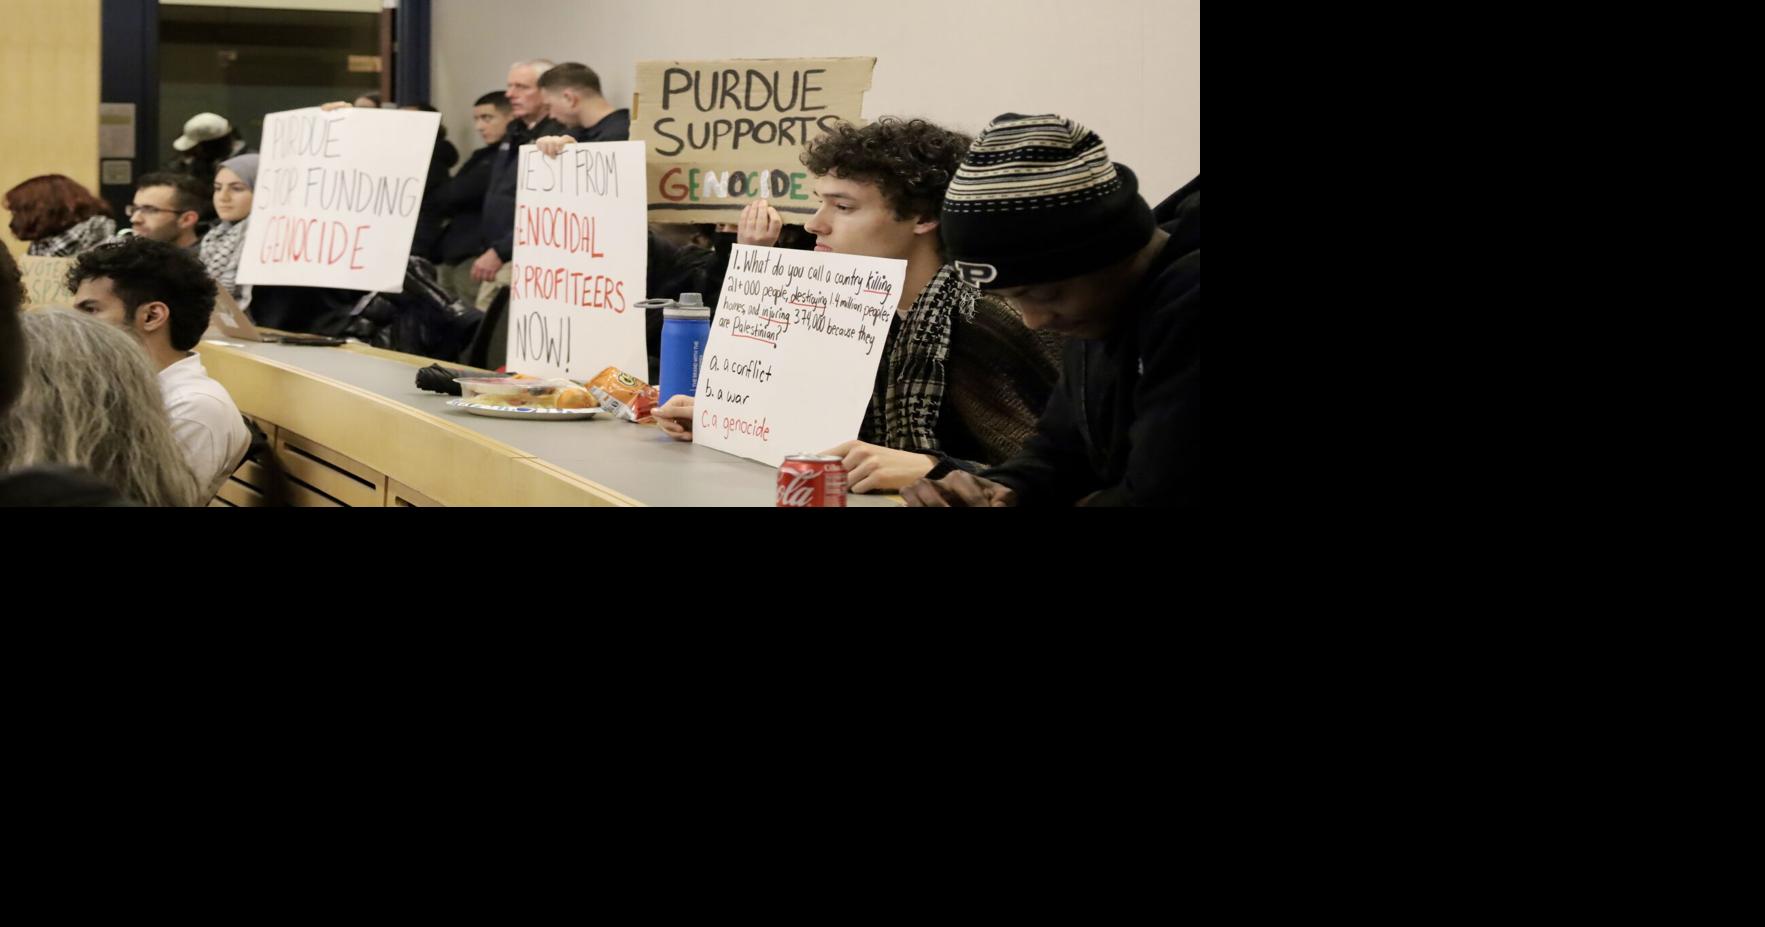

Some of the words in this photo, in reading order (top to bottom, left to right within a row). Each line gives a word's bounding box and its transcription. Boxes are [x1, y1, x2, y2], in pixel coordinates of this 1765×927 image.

[662, 67, 827, 112] PURDUE
[258, 167, 298, 210] STOP
[305, 167, 420, 218] FUNDING
[575, 150, 619, 198] FROM
[659, 167, 809, 202] GENOCIDE
[260, 216, 371, 270] GENOCIDE
[516, 205, 604, 258] ENOCIDAL
[733, 249, 741, 270] 1.
[743, 249, 771, 273] What
[772, 253, 784, 276] do
[786, 264, 804, 287] you
[807, 264, 824, 282] call
[825, 270, 831, 283] a
[954, 260, 998, 289] P
[525, 265, 626, 314] PROFITEERS
[761, 285, 789, 306] people,
[829, 292, 841, 308] 1.4
[840, 296, 862, 313] million
[516, 311, 571, 373] NOW!
[719, 317, 730, 328] are
[733, 316, 782, 349] Palestinian?
[723, 295, 746, 315] homes,
[747, 303, 761, 316] and
[761, 306, 791, 333] injuring
[826, 318, 856, 338] because
[858, 324, 875, 355] they
[709, 355, 720, 371] a.
[723, 358, 729, 372] a
[731, 360, 772, 383] conflict
[705, 378, 714, 398] b.
[717, 388, 723, 401] a
[727, 391, 750, 405] war
[711, 414, 717, 429] a
[723, 417, 770, 442] genocide
